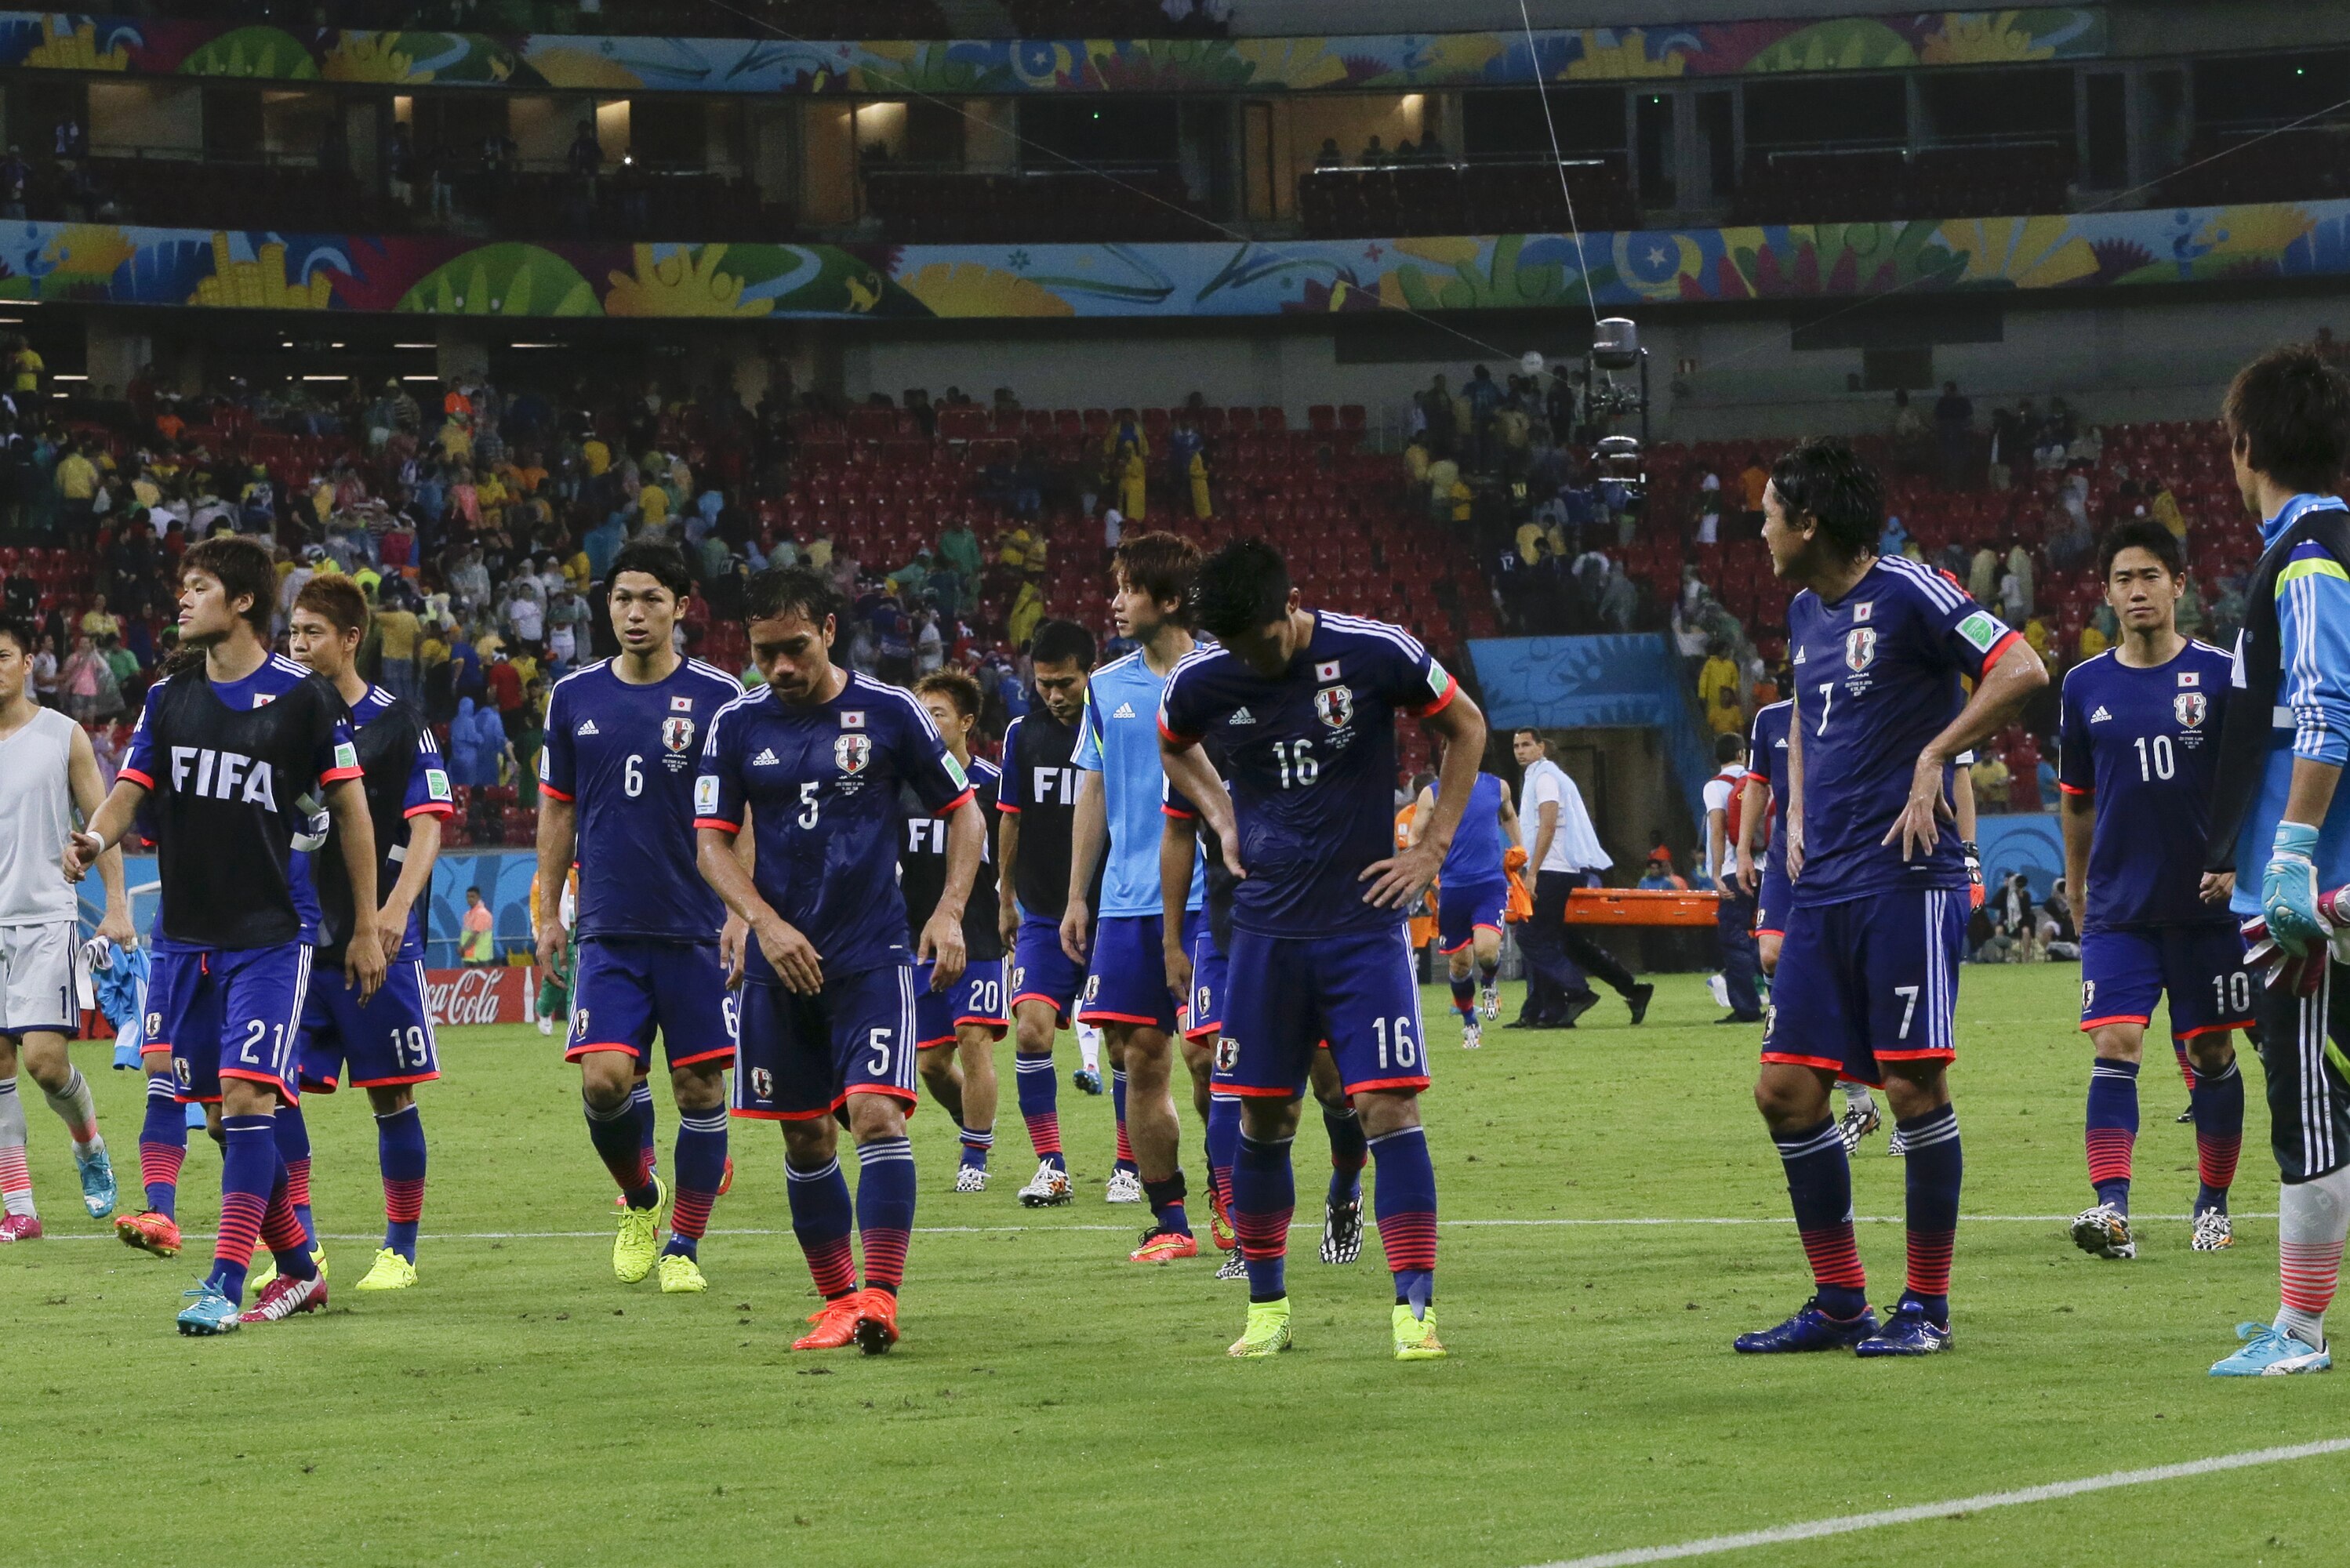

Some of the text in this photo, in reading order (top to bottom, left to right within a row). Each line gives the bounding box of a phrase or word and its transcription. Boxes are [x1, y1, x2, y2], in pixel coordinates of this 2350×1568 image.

[1818, 683, 1834, 736] 7
[171, 746, 278, 813] FIFA
[625, 754, 643, 797] 6
[1273, 739, 1318, 789] 16
[2134, 735, 2175, 782] 10
[798, 782, 819, 829] 5
[1033, 766, 1088, 805] FI
[59, 985, 67, 1019] 1
[968, 980, 998, 1013] 20
[1894, 985, 1920, 1039] 7
[2212, 971, 2250, 1014] 10
[721, 996, 739, 1039] 6
[240, 1018, 284, 1069] 21
[390, 1025, 428, 1069] 19
[868, 1028, 892, 1076] 5
[1372, 1016, 1416, 1069] 16
